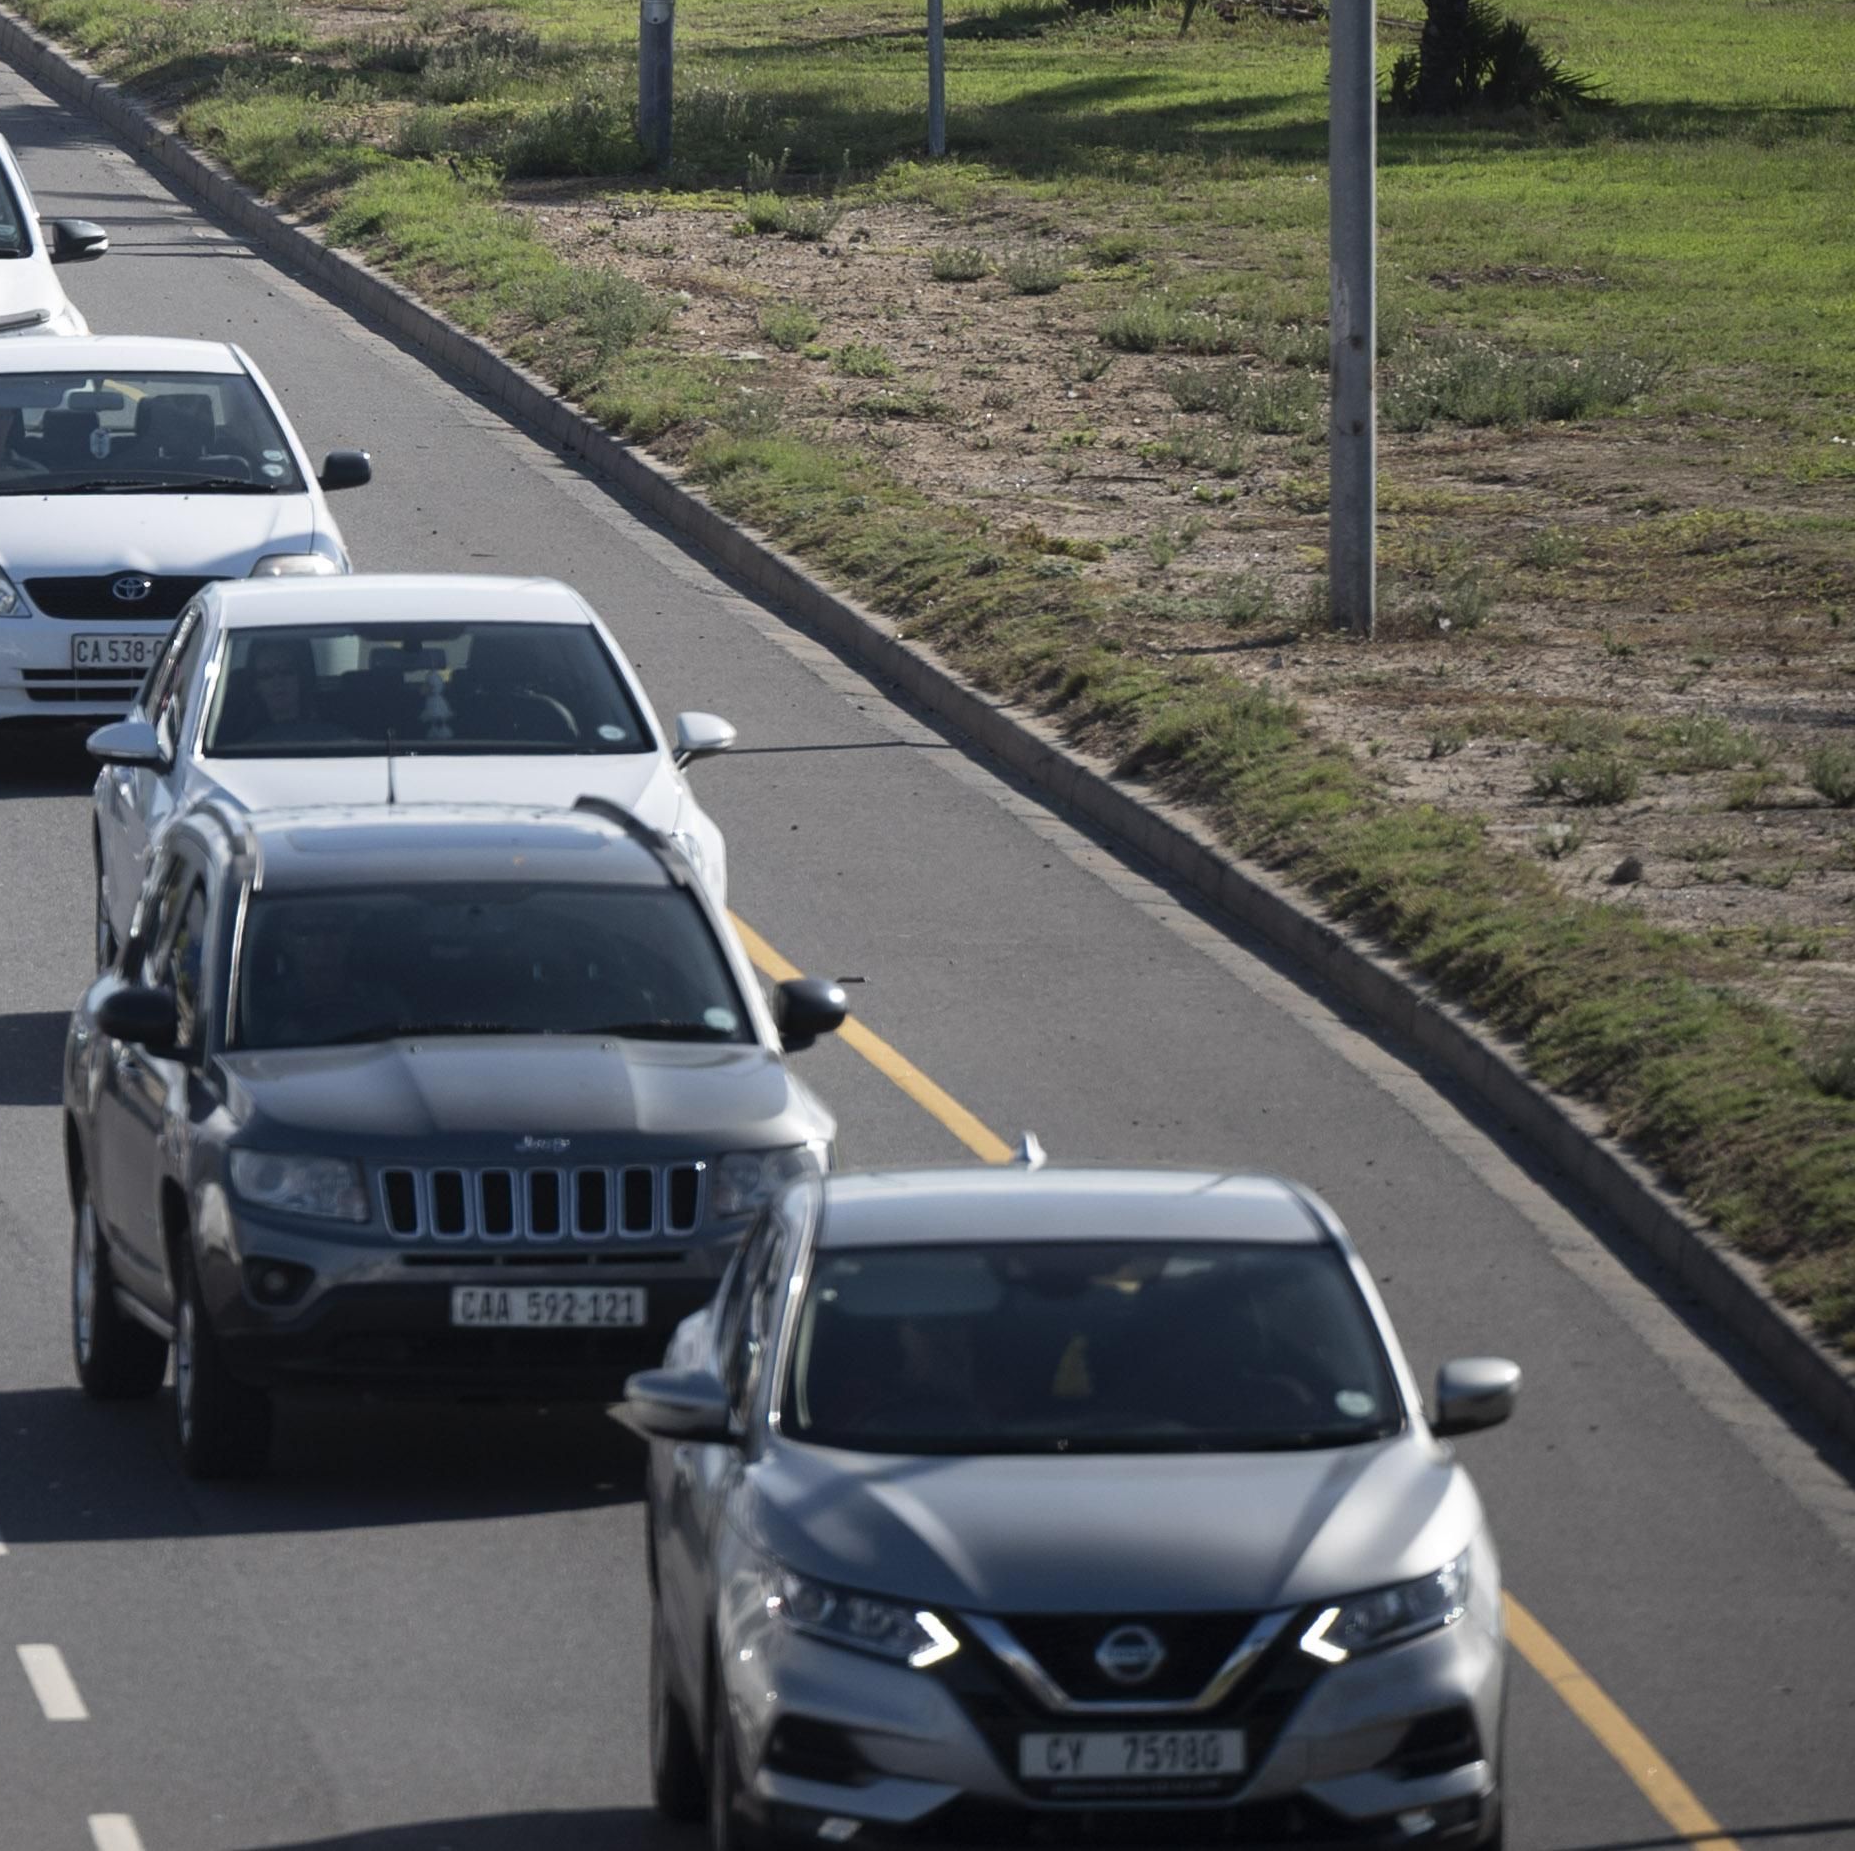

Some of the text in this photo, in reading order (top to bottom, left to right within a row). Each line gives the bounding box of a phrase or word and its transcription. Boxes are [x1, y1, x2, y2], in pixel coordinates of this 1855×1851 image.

[76, 641, 100, 662] CA
[461, 1290, 635, 1322] CAA 592-121
[1046, 1737, 1084, 1772] CY
